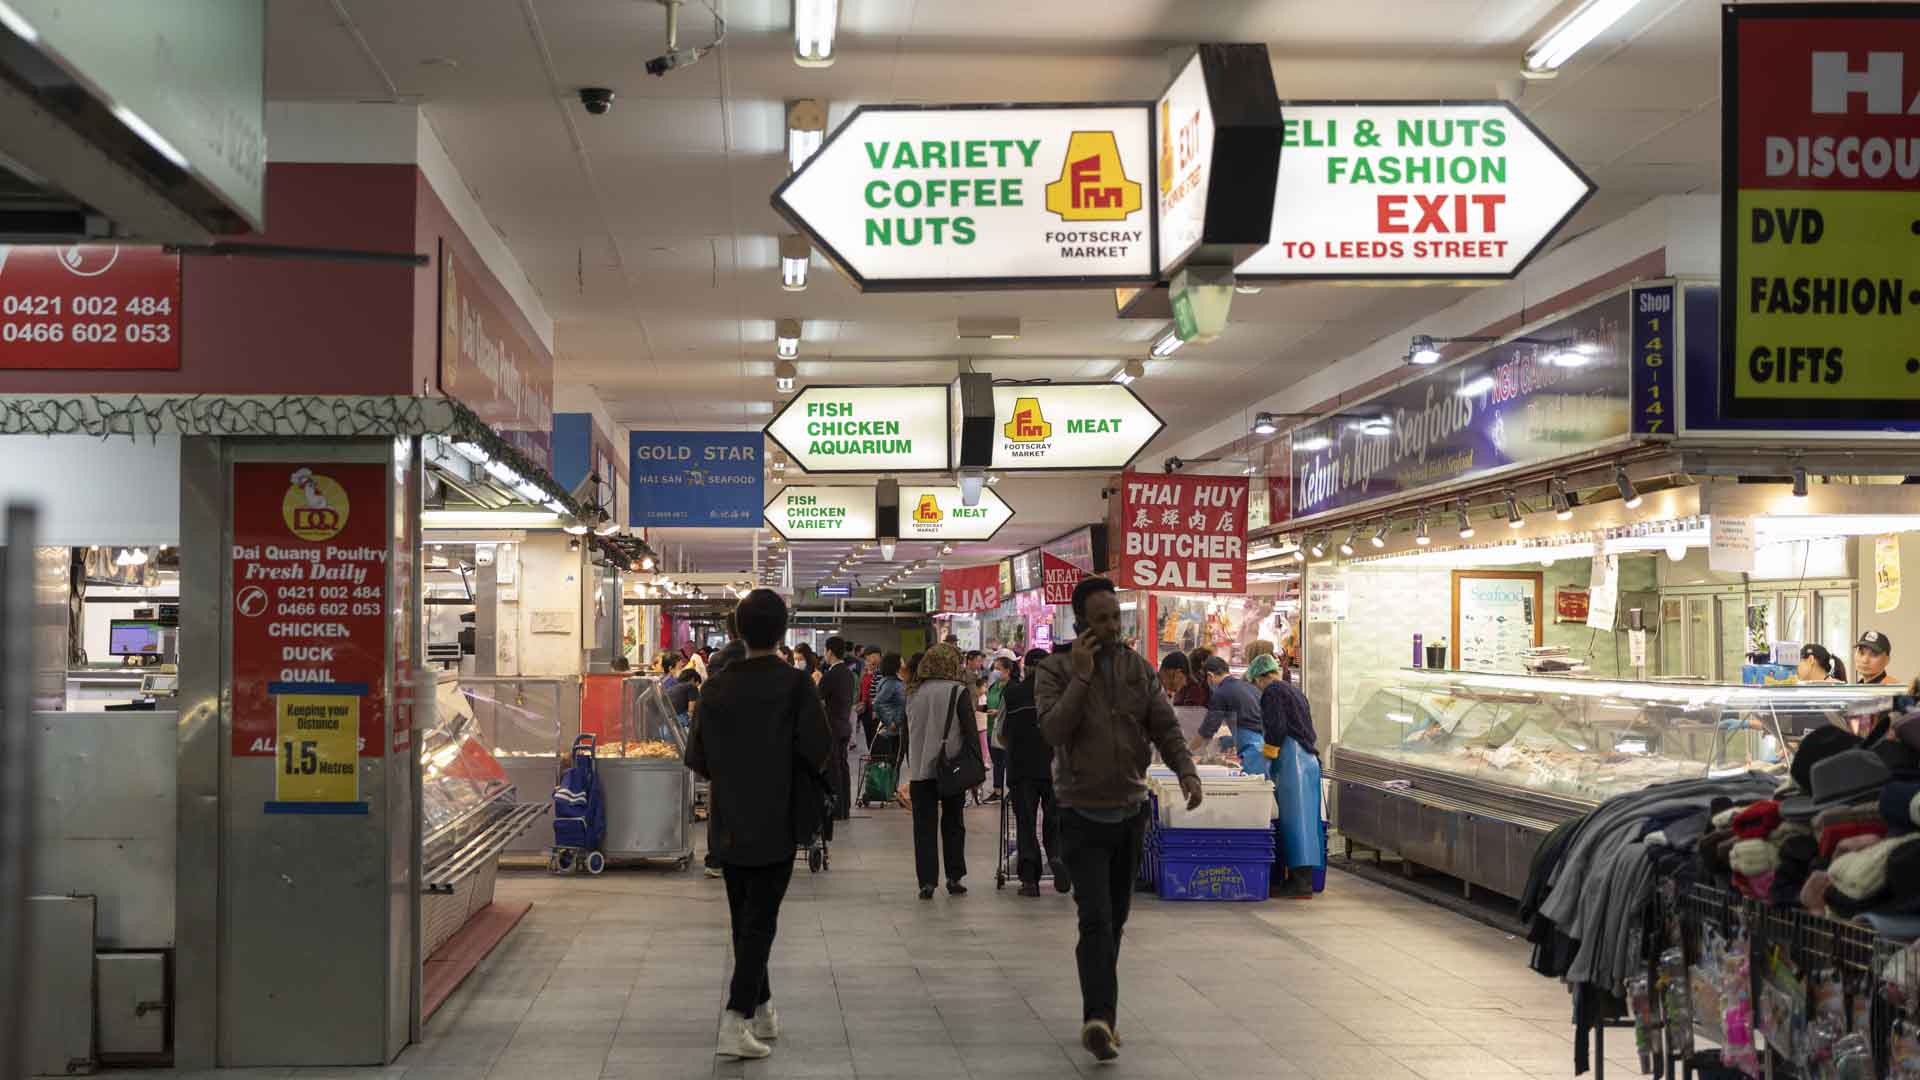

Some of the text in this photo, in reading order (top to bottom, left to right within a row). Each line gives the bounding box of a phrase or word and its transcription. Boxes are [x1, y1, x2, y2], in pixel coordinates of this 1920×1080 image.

[1811, 51, 1920, 115] H
[1354, 119, 1381, 148] &
[1397, 118, 1507, 148] NUTS
[864, 140, 1041, 169] VARIETY
[1327, 156, 1507, 184] FASHION
[864, 178, 1024, 208] COFFEE
[1377, 194, 1506, 234] EXIT
[865, 216, 977, 246] NUTS
[1751, 207, 1825, 245] DVD
[1045, 231, 1142, 243] FOOTSCRAY
[1060, 246, 1129, 258] MARKET
[1282, 241, 1508, 259] TO LEEDS STREET
[1640, 293, 1670, 312] Shop
[1749, 277, 1903, 316] FASHION
[3, 296, 171, 316] 0421 002 484
[3, 323, 171, 343] 0466 602 053
[1749, 346, 1844, 384] GIFTS
[807, 403, 853, 417] FISH
[807, 421, 899, 436] CHICKEN
[1067, 418, 1122, 433] MEAT
[808, 440, 912, 455] AQUARIUM
[1298, 447, 1340, 512] Kelvin
[1352, 435, 1390, 494] Ryan
[1393, 370, 1473, 465] Seafoods
[638, 446, 755, 460] GOLD STAR
[708, 475, 755, 484] SEAFOOD
[787, 496, 817, 505] FISH
[1128, 483, 1181, 505] THAI
[1194, 486, 1243, 507] HUY
[787, 507, 846, 517] CHICKEN
[952, 508, 988, 518] MEAT
[788, 519, 843, 529] VARIETY
[1126, 532, 1242, 559] BUTCHER
[232, 546, 387, 565] Dai Quang Poultry
[246, 563, 367, 583] Fresh Daily
[1046, 569, 1081, 584] MEAT
[1133, 560, 1232, 589] SALE
[278, 587, 381, 599] 0421 002 484
[1046, 584, 1075, 602] SAL
[278, 604, 381, 615] 0466 602 053
[268, 623, 350, 637] CHICKEN
[283, 647, 334, 661] DUCK
[280, 669, 335, 683] QUAIL
[287, 704, 349, 717] Keeping your
[297, 718, 339, 730] Distance
[284, 742, 354, 775] 1.5 Metres
